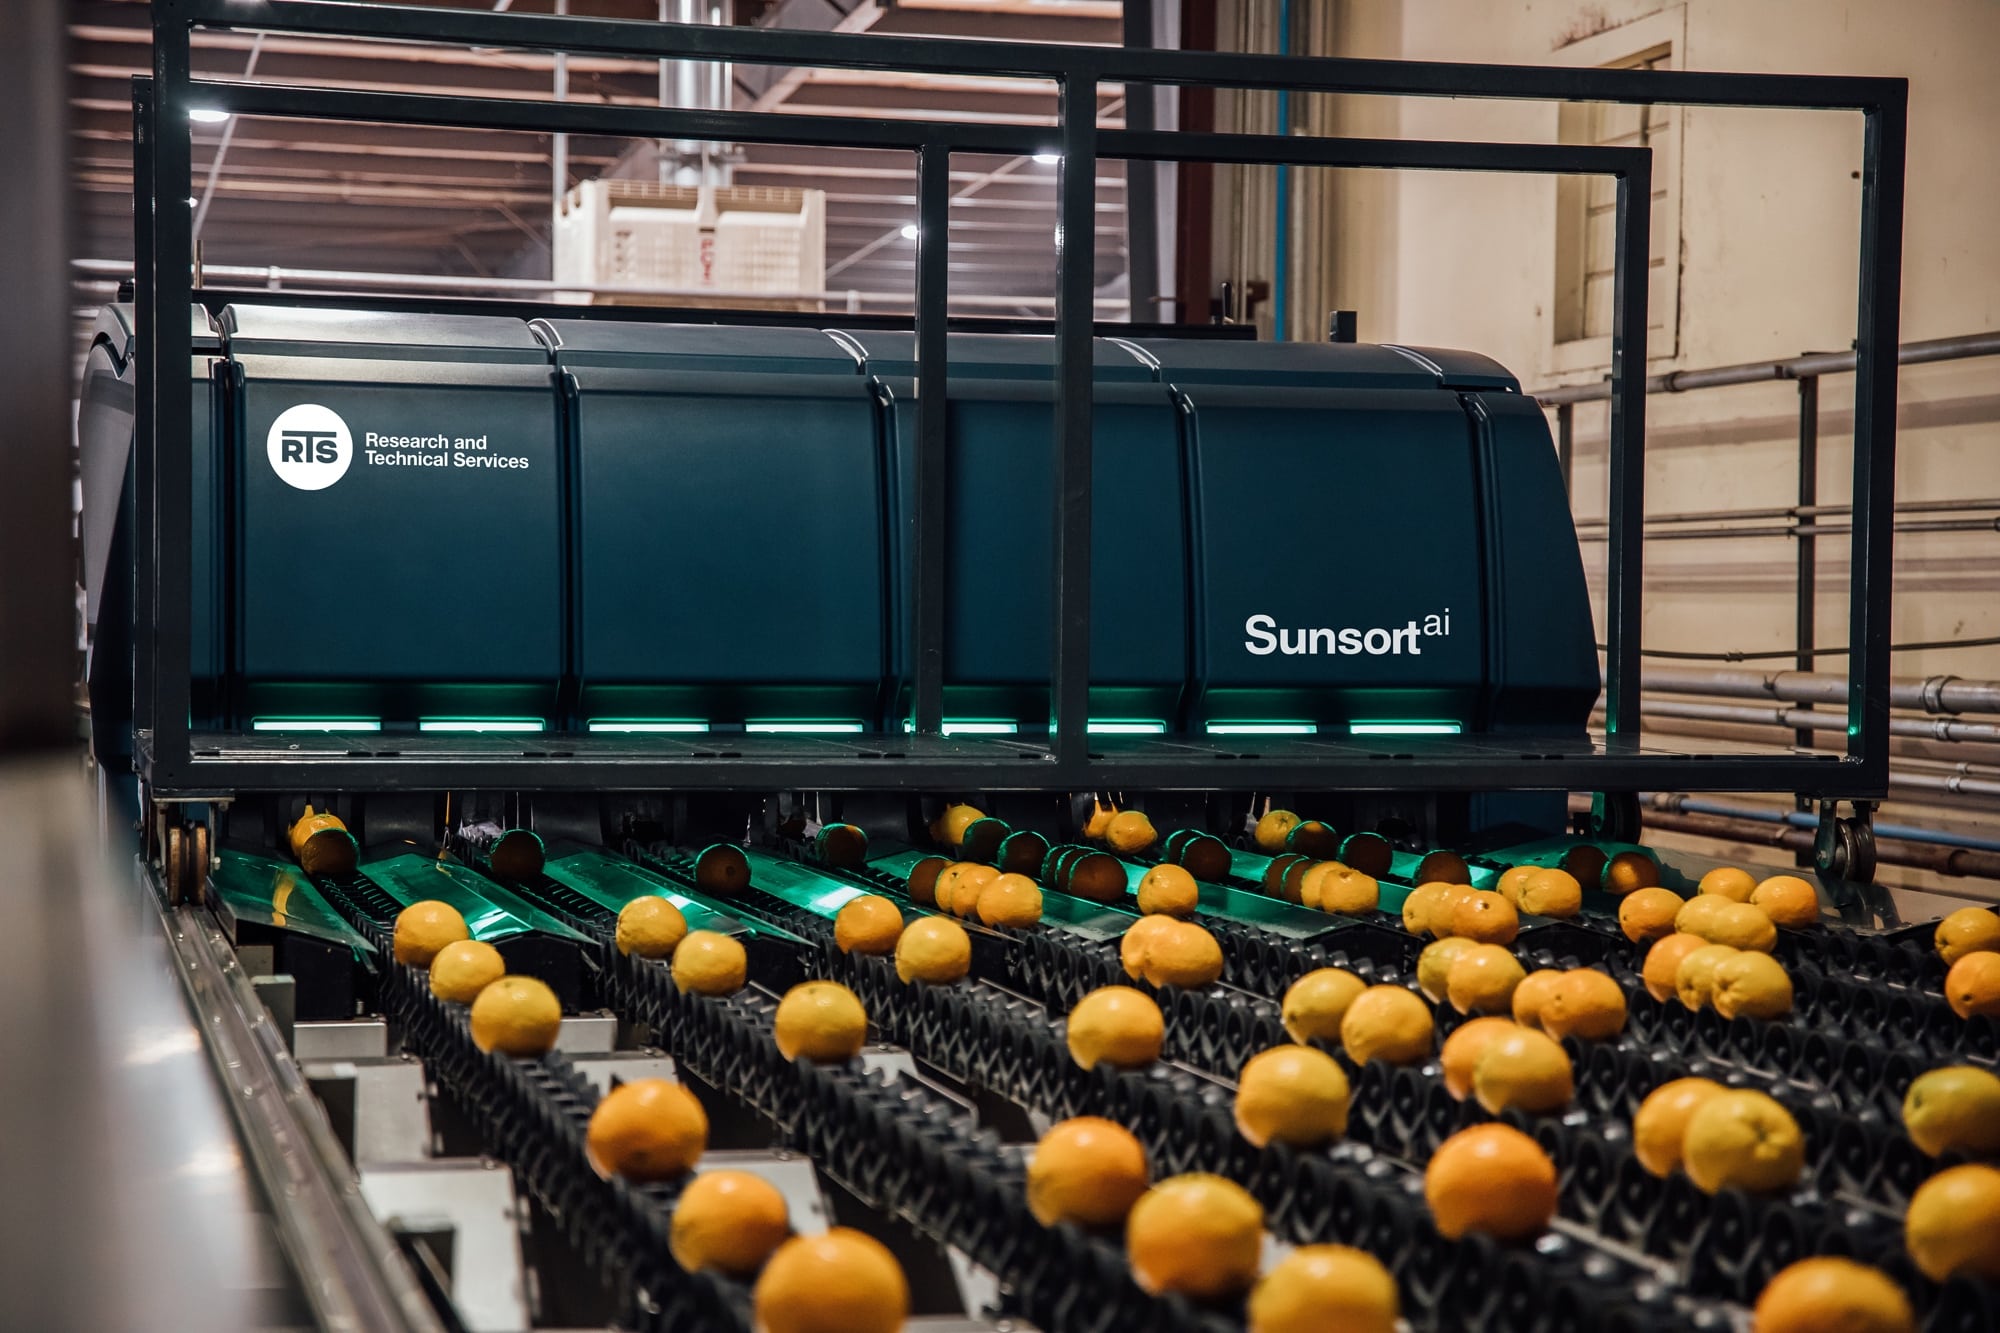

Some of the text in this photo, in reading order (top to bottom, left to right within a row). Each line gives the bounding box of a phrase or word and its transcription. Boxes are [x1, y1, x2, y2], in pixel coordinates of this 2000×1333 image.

[281, 430, 338, 463] RTS
[365, 432, 487, 450] Research and
[364, 450, 529, 469] Technical Services
